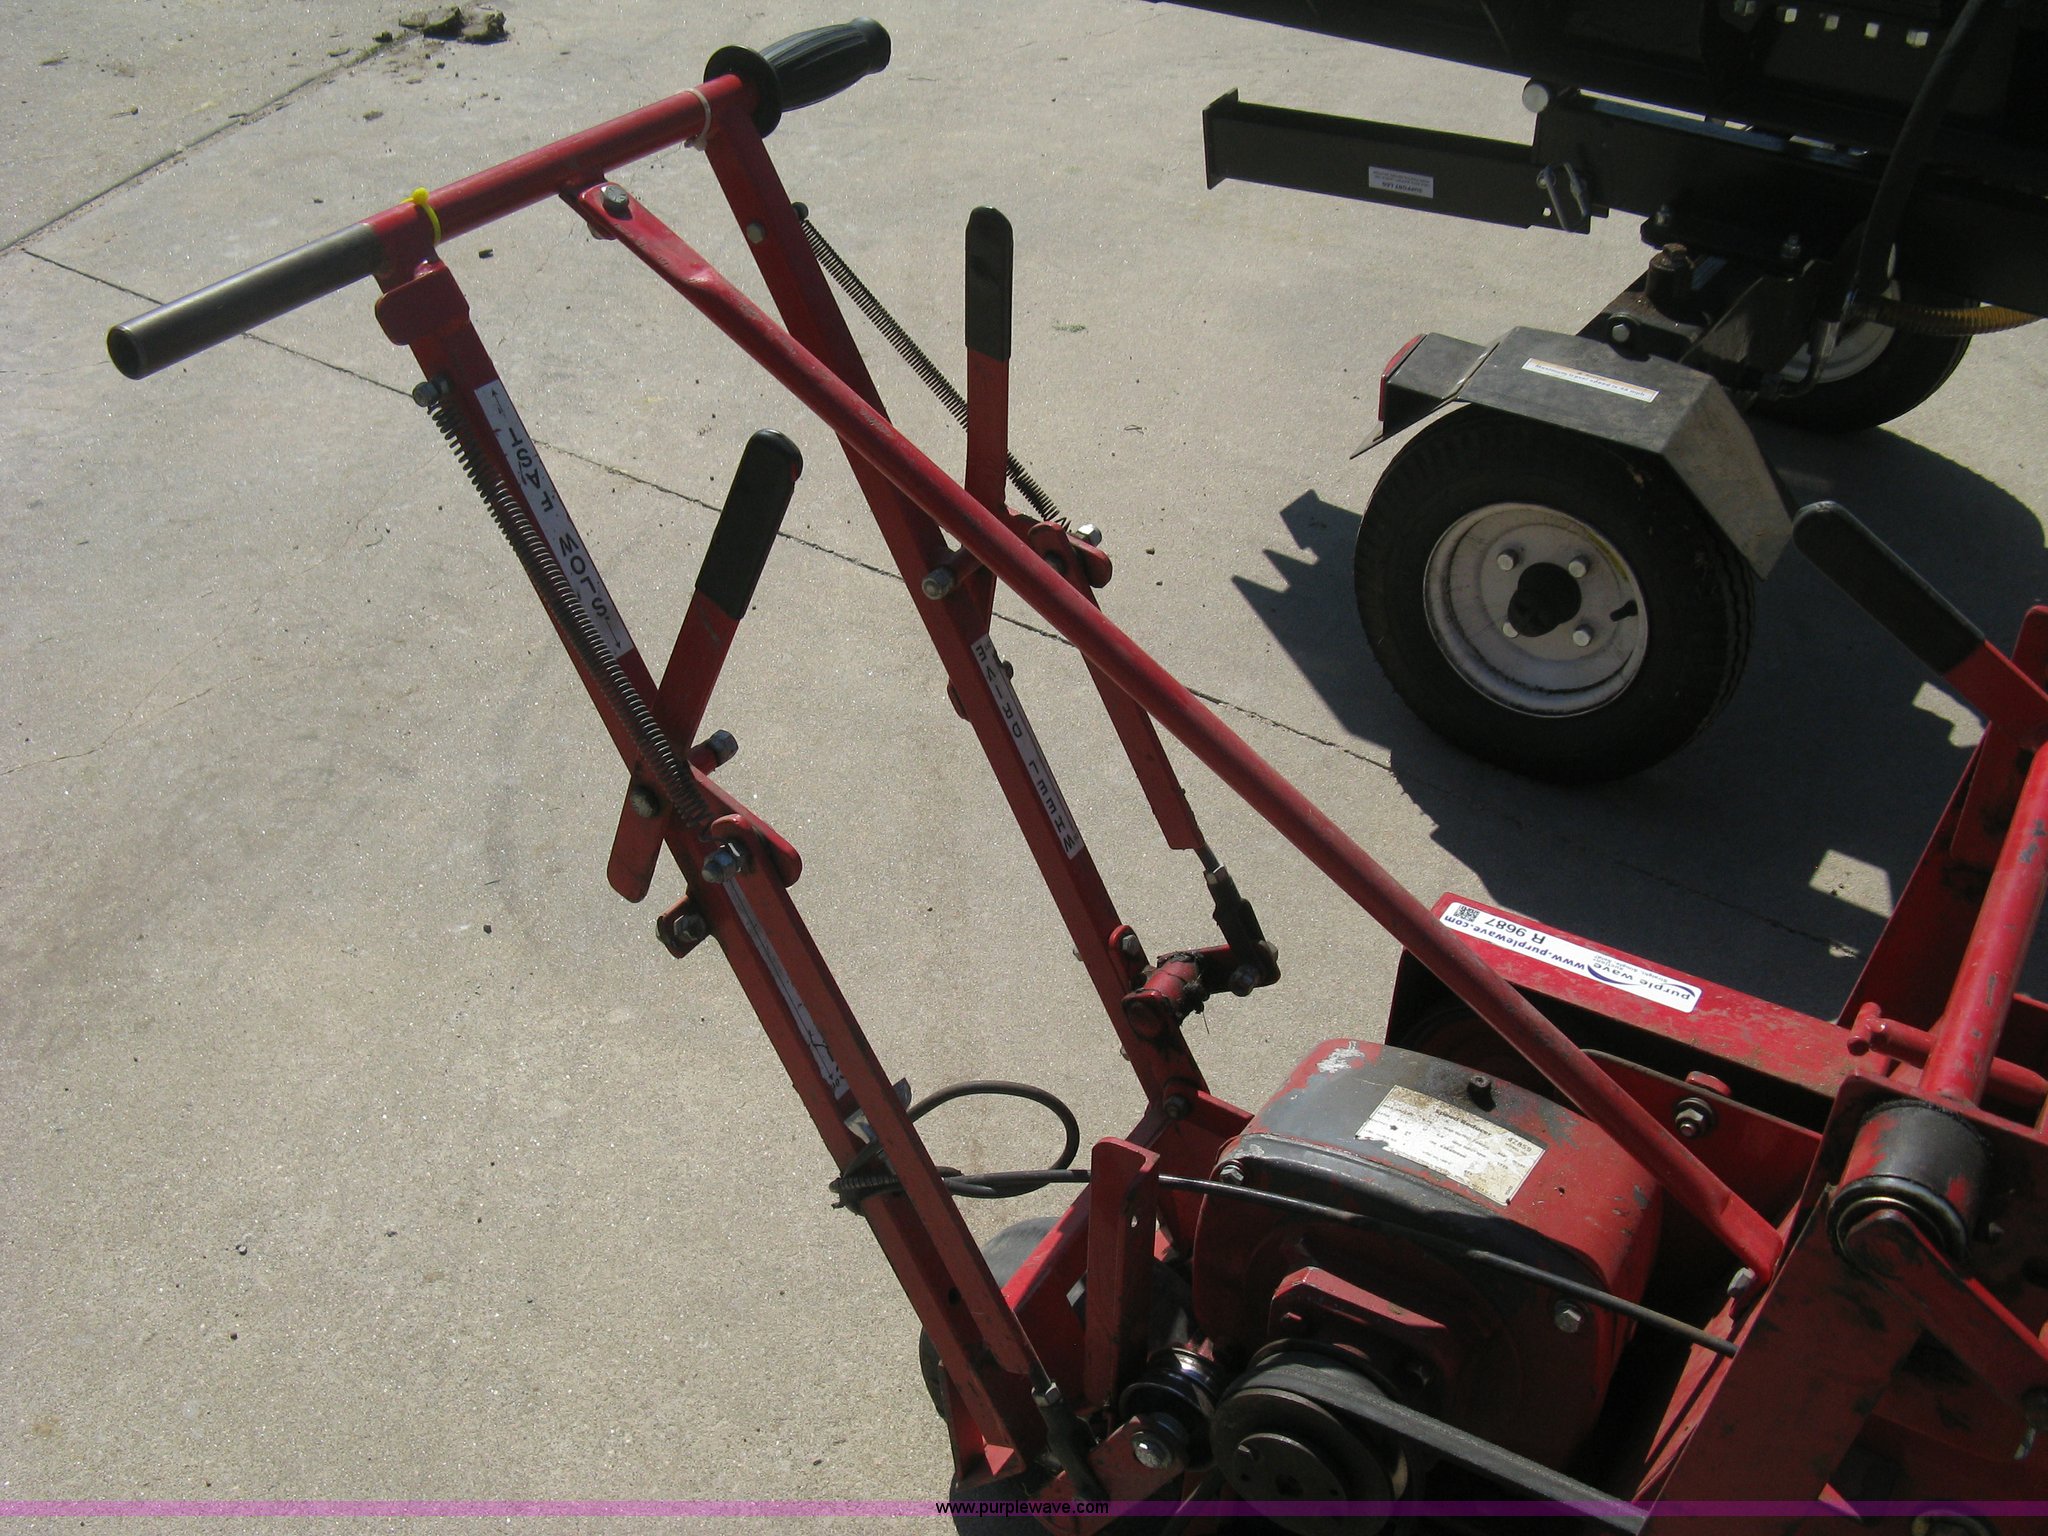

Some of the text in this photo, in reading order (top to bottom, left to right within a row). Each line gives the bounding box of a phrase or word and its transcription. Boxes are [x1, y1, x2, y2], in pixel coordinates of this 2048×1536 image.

[508, 427, 608, 620] SLOW FAST
[975, 645, 1075, 853] WHEEL DRIVE
[1444, 915, 1585, 970] www.purplewave.com
[1484, 918, 1546, 945] R 9687
[1593, 963, 1691, 1000] purple wave
